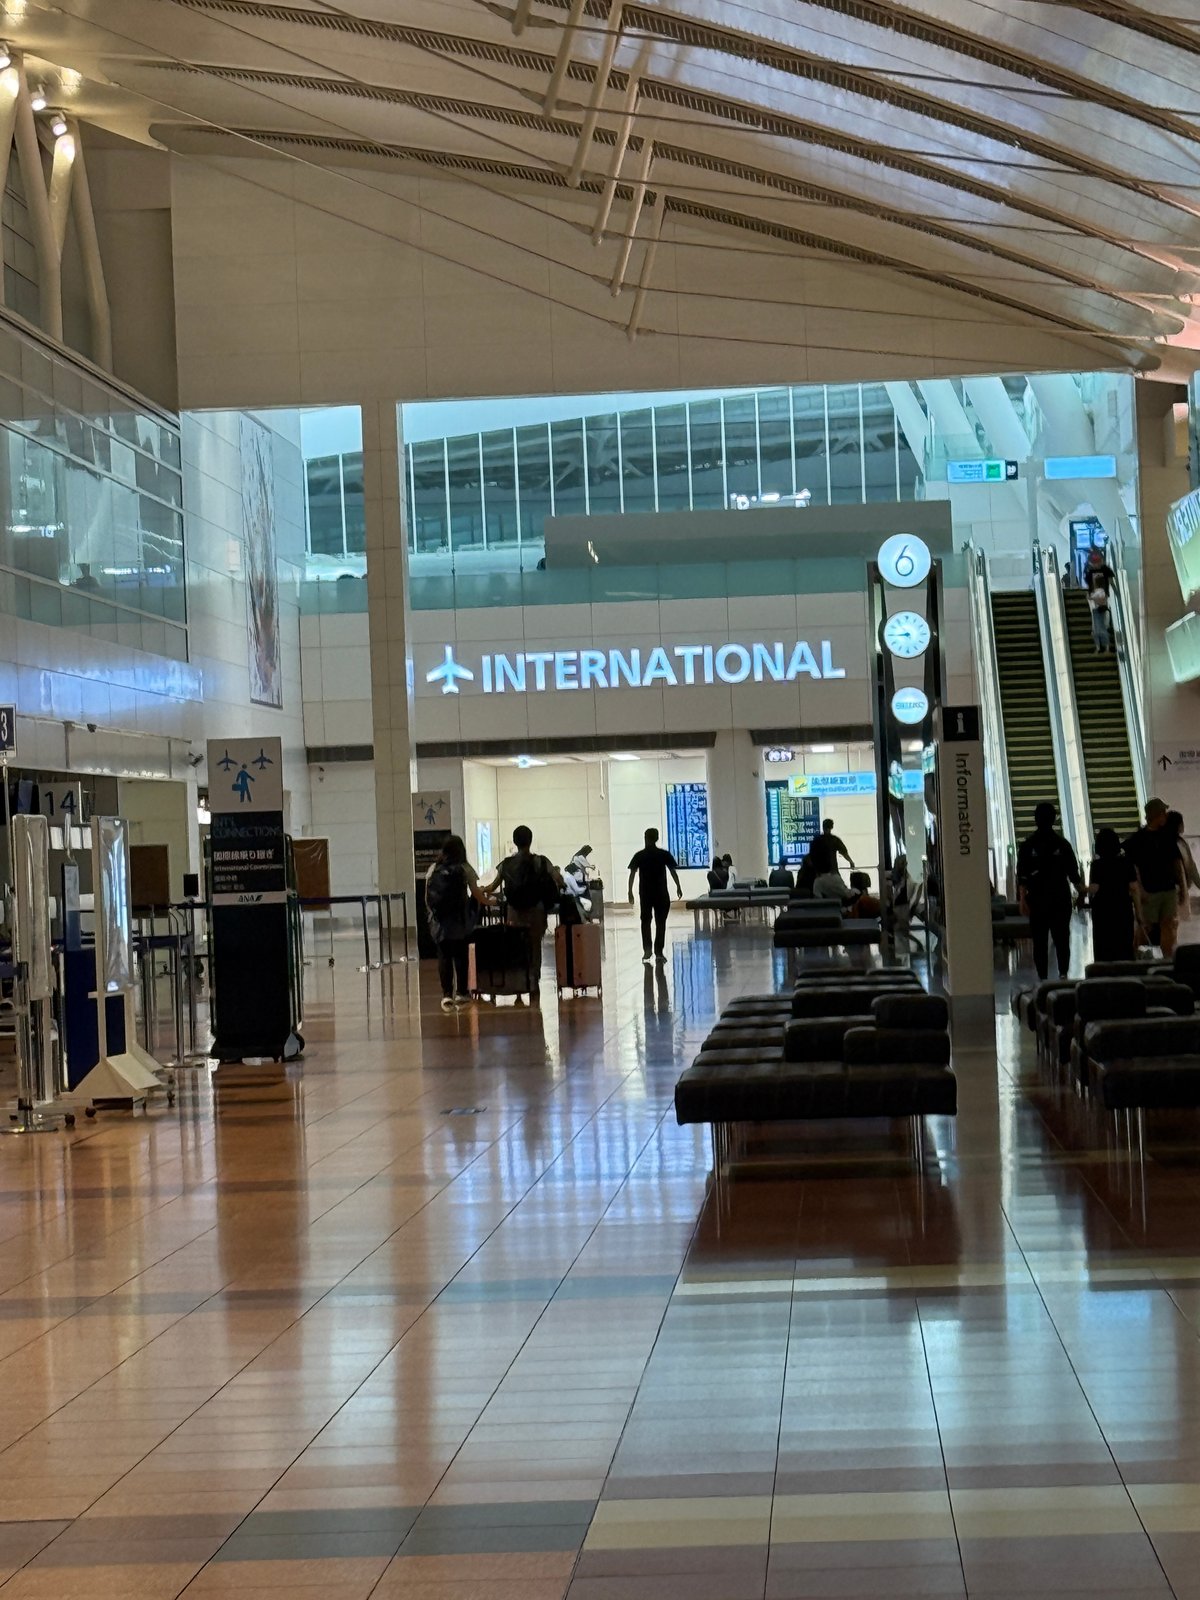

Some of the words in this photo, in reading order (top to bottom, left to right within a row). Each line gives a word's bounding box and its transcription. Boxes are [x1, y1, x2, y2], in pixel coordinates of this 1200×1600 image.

[895, 544, 915, 577] 6
[481, 640, 846, 693] INTERNATIONAL
[44, 789, 77, 817] 14
[955, 753, 974, 856] Information
